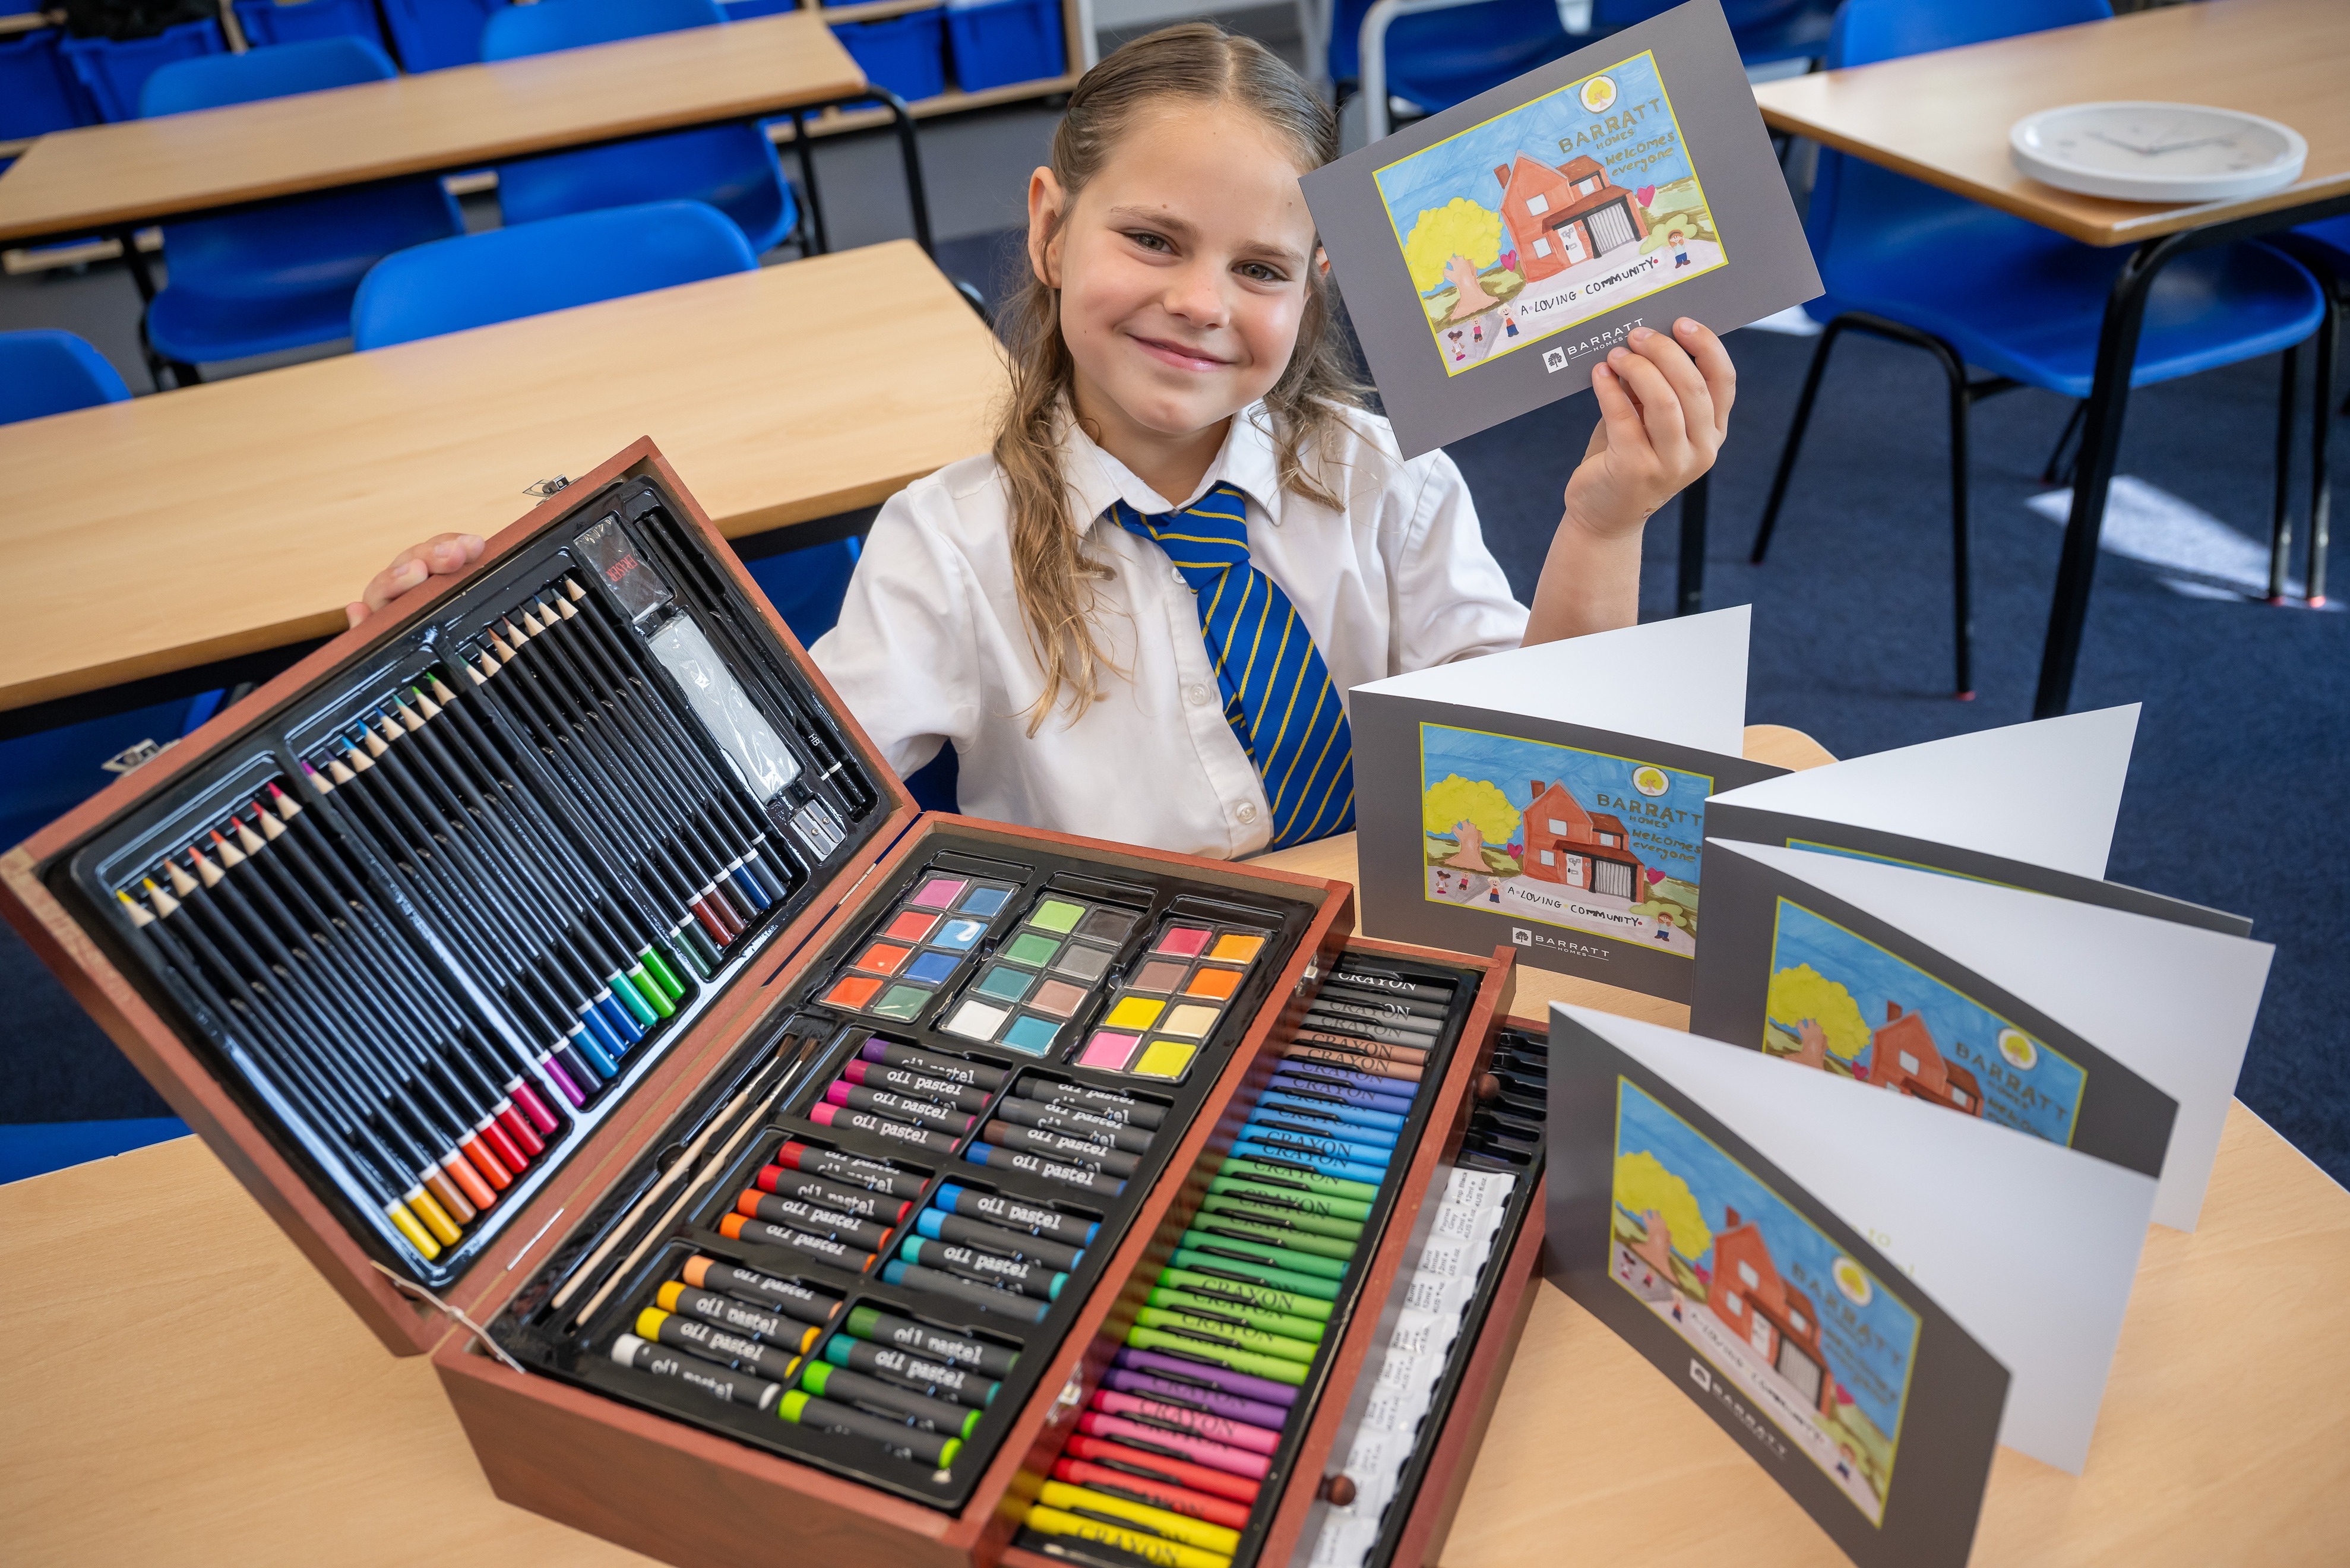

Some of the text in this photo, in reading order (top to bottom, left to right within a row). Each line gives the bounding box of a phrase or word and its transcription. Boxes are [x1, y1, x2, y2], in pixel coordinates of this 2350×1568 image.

[1558, 98, 1659, 154] BARRATT
[1596, 128, 1634, 149] HOMES
[1612, 147, 1674, 176] everyone
[1521, 305, 1529, 316] A
[1535, 291, 1577, 312] LOVING
[1567, 318, 1643, 355] BARRATT
[1593, 336, 1624, 352] HOMES
[605, 554, 638, 581] ERASER
[808, 734, 820, 746] HB
[1597, 794, 1703, 826] BARRATT
[1630, 815, 1668, 829] HOMES
[1633, 842, 1696, 862] everyone
[1507, 886, 1515, 895] A
[1520, 890, 1562, 909] LOVING
[1535, 935, 1609, 957] BARRATT
[1558, 947, 1587, 957] HOMES
[1308, 1048, 1390, 1073] CRAYON
[887, 1071, 963, 1096] oil pastel
[872, 1092, 898, 1106] oil
[900, 1099, 949, 1120] pastel
[852, 1115, 929, 1144] oil pastel
[1055, 1137, 1109, 1157] pastel
[1267, 1131, 1353, 1158] CRAYON
[1012, 1155, 1039, 1171] oil
[1042, 1163, 1095, 1186] pastel
[782, 1200, 862, 1231] oil pastel
[978, 1197, 1062, 1231] oil pastel
[766, 1225, 847, 1256] oil pastel
[944, 1247, 972, 1264] oil
[973, 1254, 1030, 1279] pastel
[696, 1298, 725, 1317] oil
[680, 1323, 765, 1361] oil pastel
[894, 1327, 923, 1346] oil
[875, 1351, 966, 1390] oil pastel
